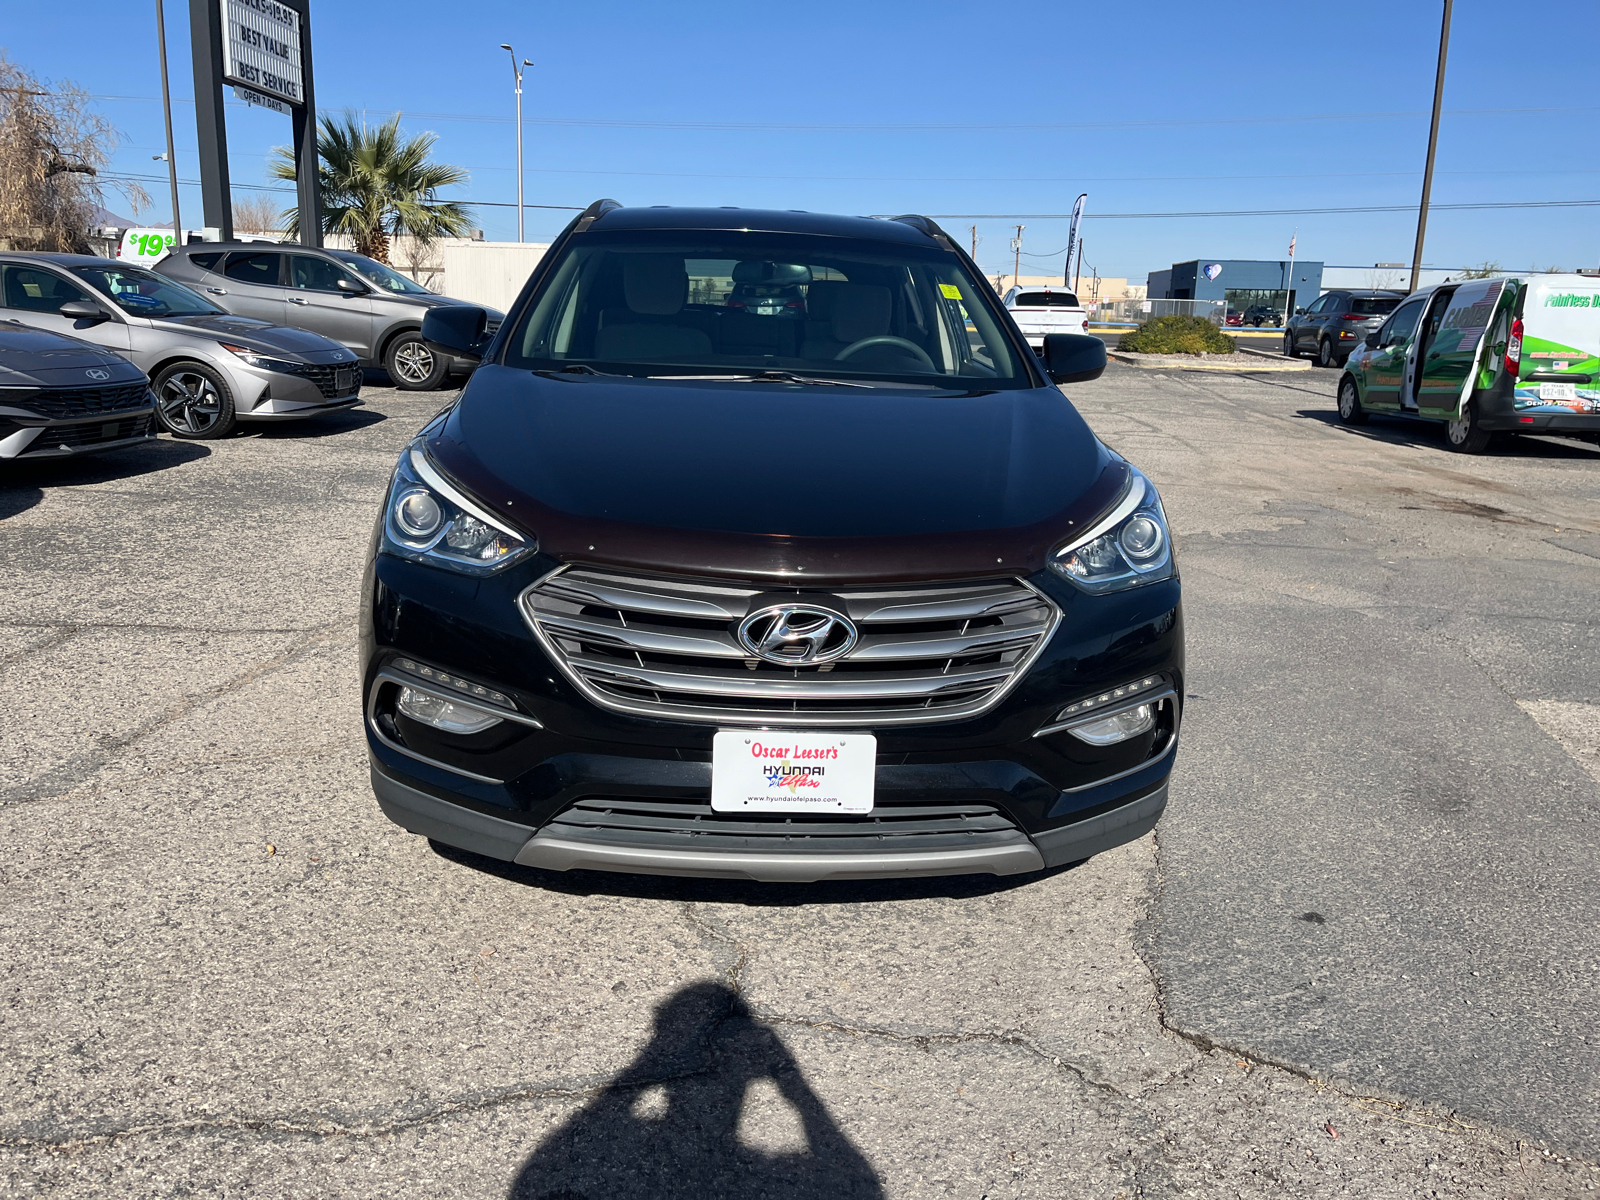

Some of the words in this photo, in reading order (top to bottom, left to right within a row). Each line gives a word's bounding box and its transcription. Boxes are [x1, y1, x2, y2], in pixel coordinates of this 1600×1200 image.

[241, 25, 261, 48] BEST
[262, 35, 289, 60] VALUE
[239, 61, 260, 84] BEST
[262, 71, 297, 98] SERVICE
[243, 90, 261, 104] OPEN
[262, 97, 266, 106] 7
[267, 98, 283, 111] DAYS
[1544, 293, 1591, 307] Paintless
[751, 742, 790, 759] Oscar
[793, 745, 838, 760] Leeser's
[763, 765, 825, 776] HYUNDAI
[779, 774, 799, 787] El
[794, 773, 821, 788] Paso
[747, 795, 838, 803] www.hyundaiofelpaso.com
